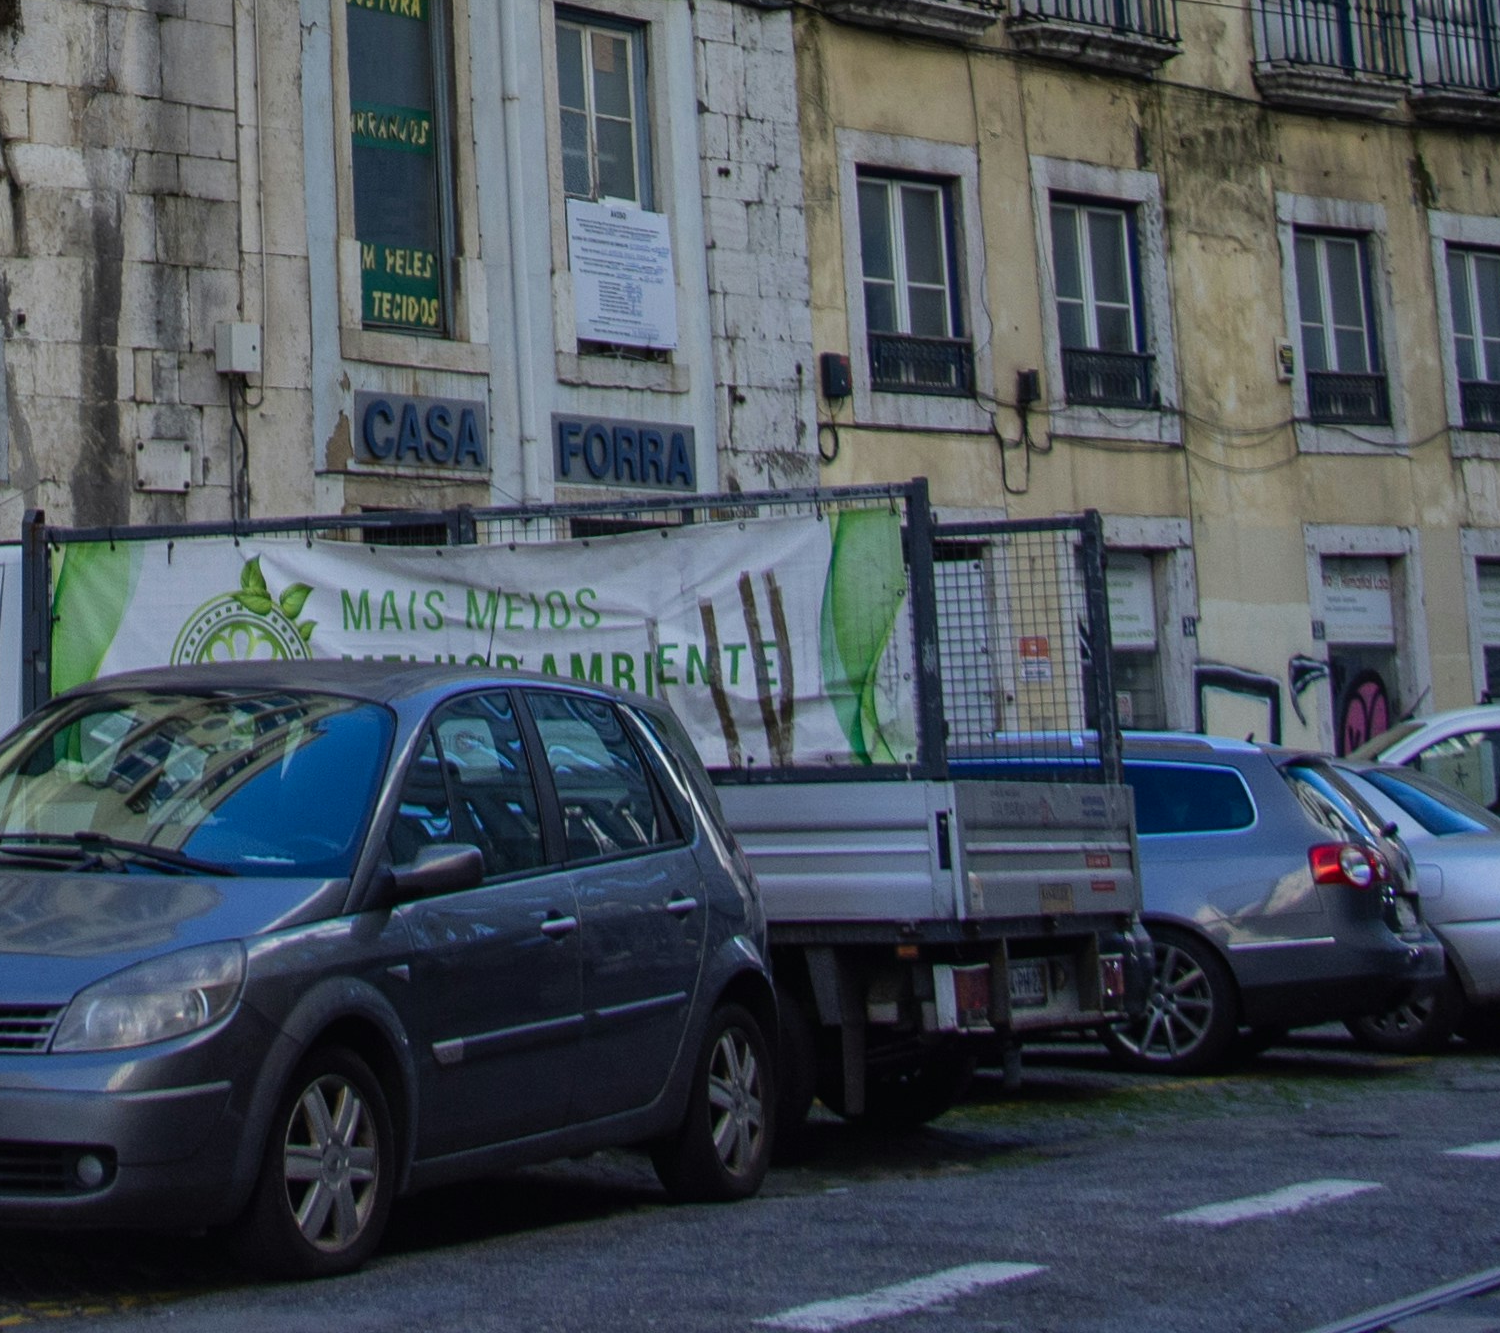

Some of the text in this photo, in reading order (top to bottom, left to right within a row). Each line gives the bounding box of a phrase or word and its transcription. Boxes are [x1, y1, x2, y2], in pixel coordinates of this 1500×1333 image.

[372, 290, 439, 326] TECIDOS
[363, 399, 485, 466] CASA
[558, 421, 694, 486] FORRA
[340, 587, 601, 631] MAIS MEIOS
